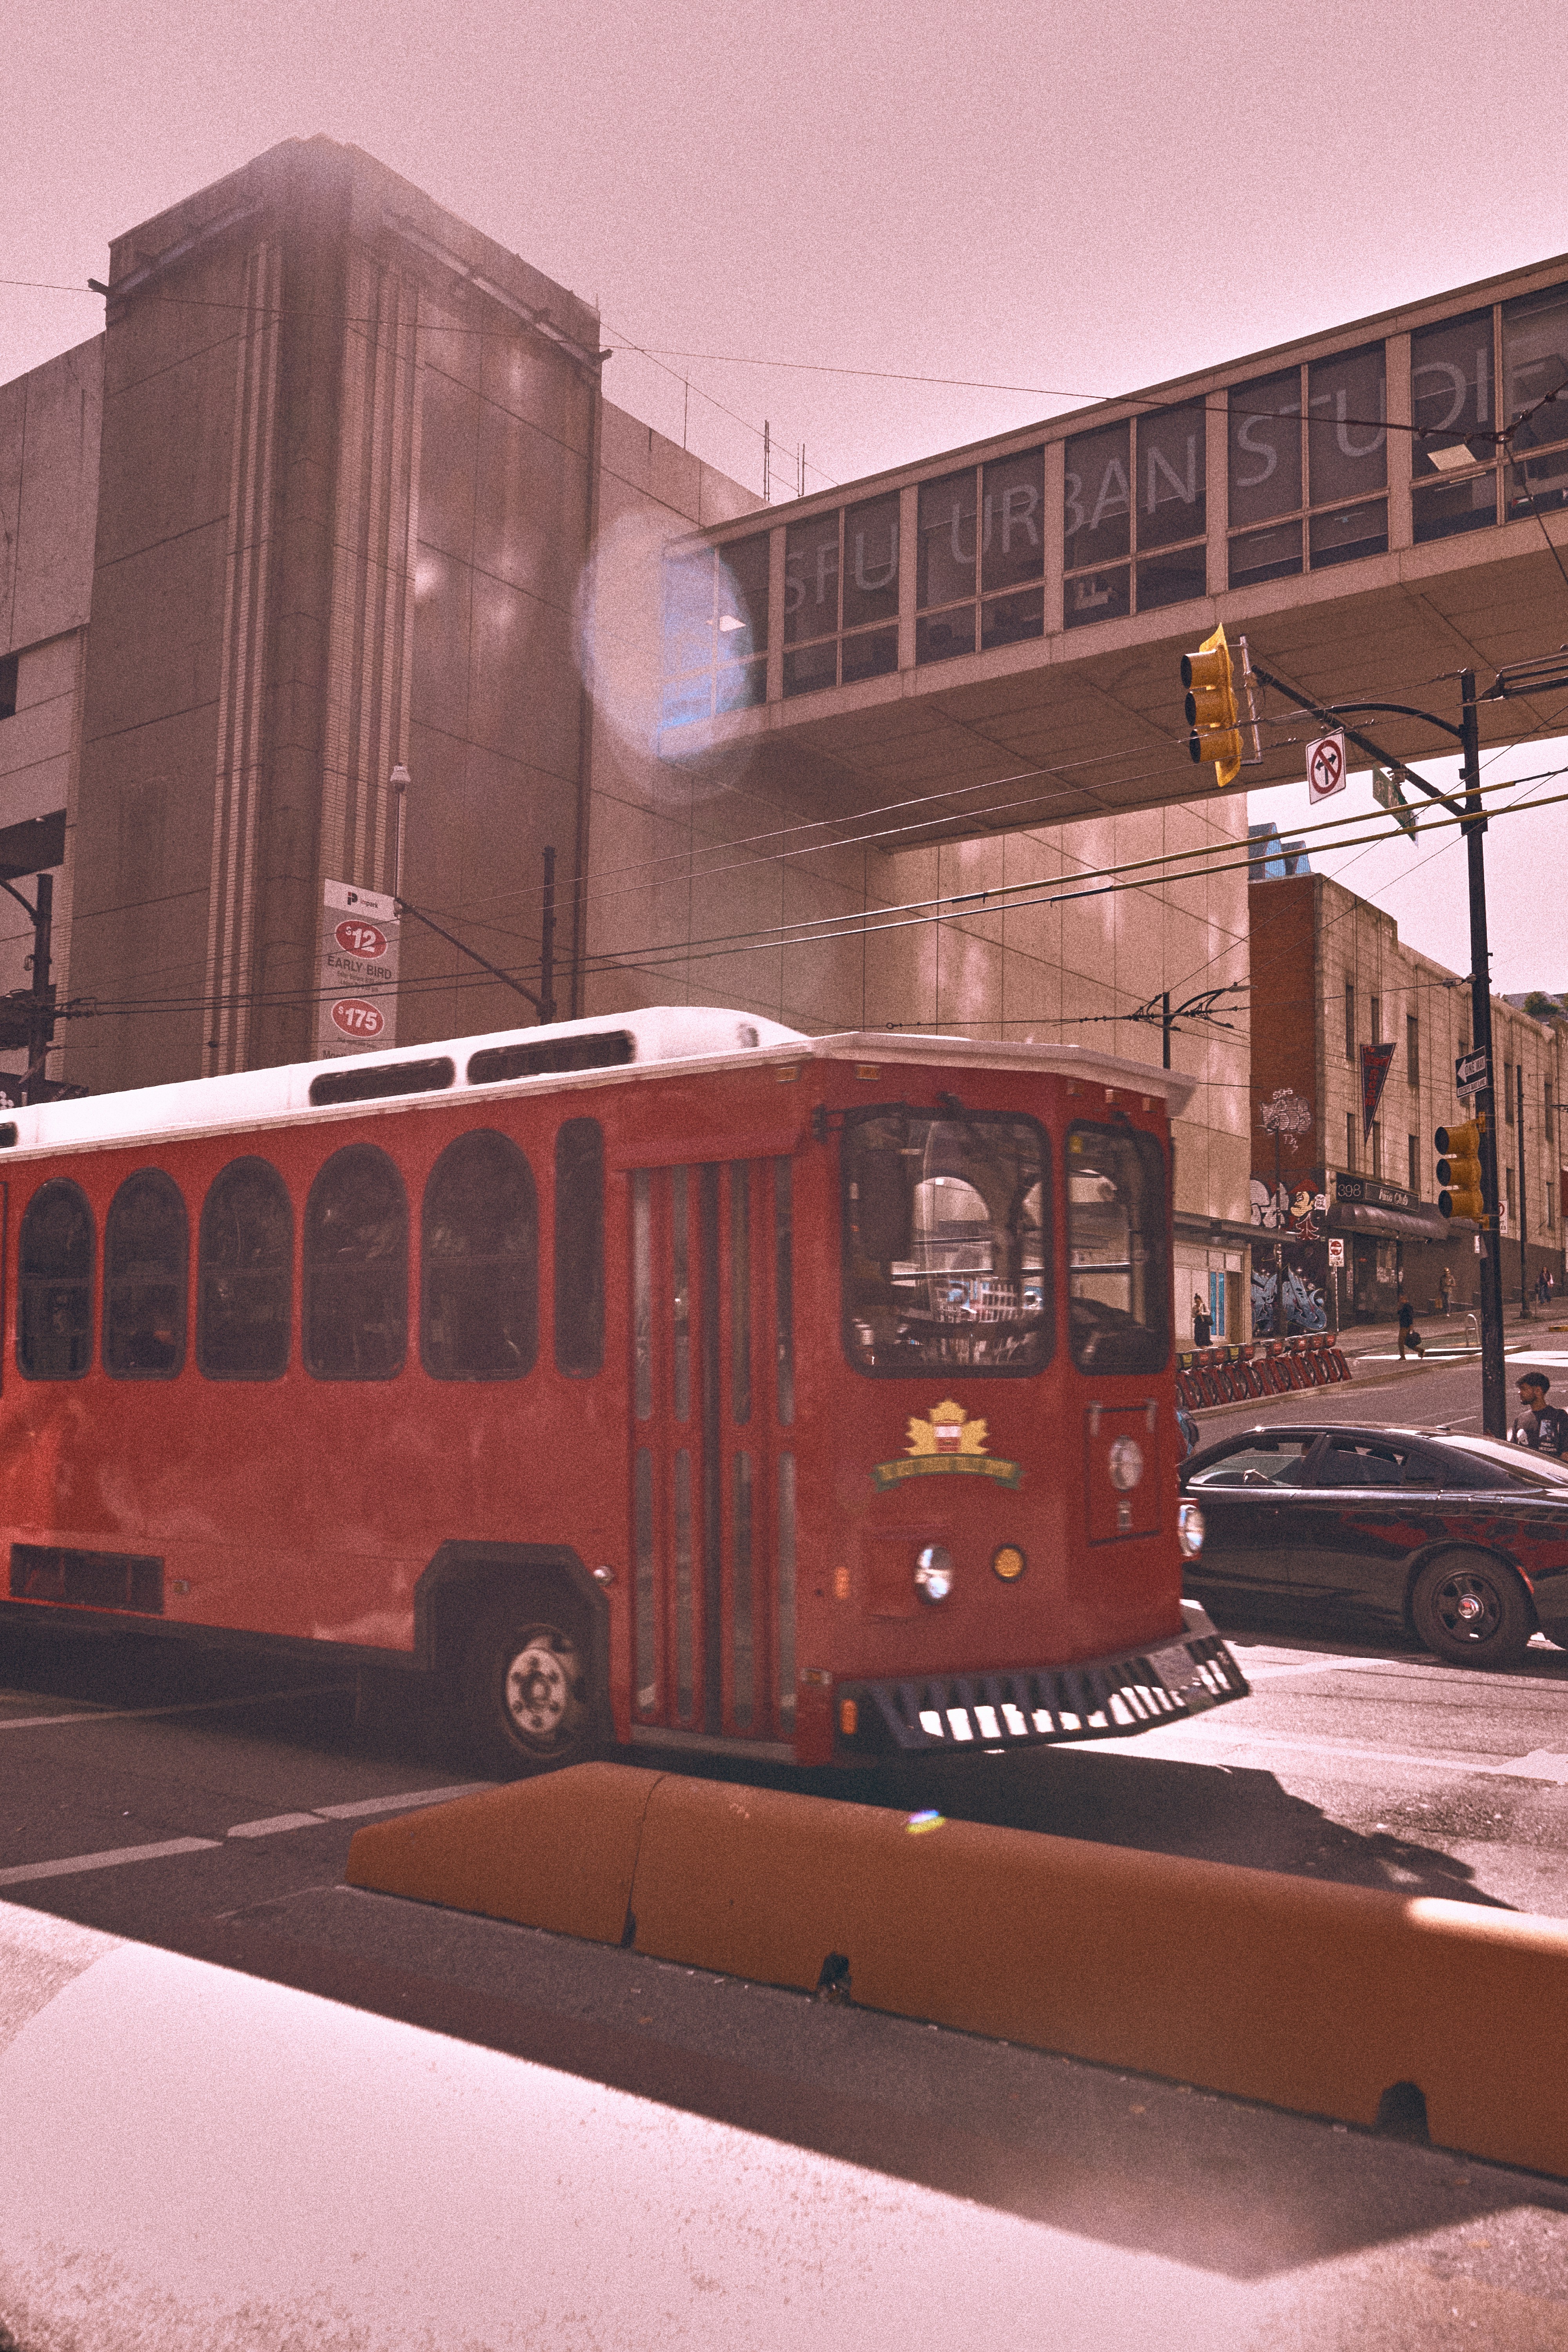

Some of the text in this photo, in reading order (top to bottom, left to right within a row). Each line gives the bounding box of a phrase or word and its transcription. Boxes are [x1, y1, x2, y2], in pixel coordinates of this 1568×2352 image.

[785, 522, 899, 614] SFU
[950, 434, 1196, 564] URBAN
[360, 898, 378, 908] impark
[345, 926, 376, 953] $12
[327, 955, 392, 980] EARLY BIRD
[338, 1005, 377, 1031] $175
[1465, 1058, 1485, 1075] ONE WAY
[1337, 1183, 1361, 1198] 398
